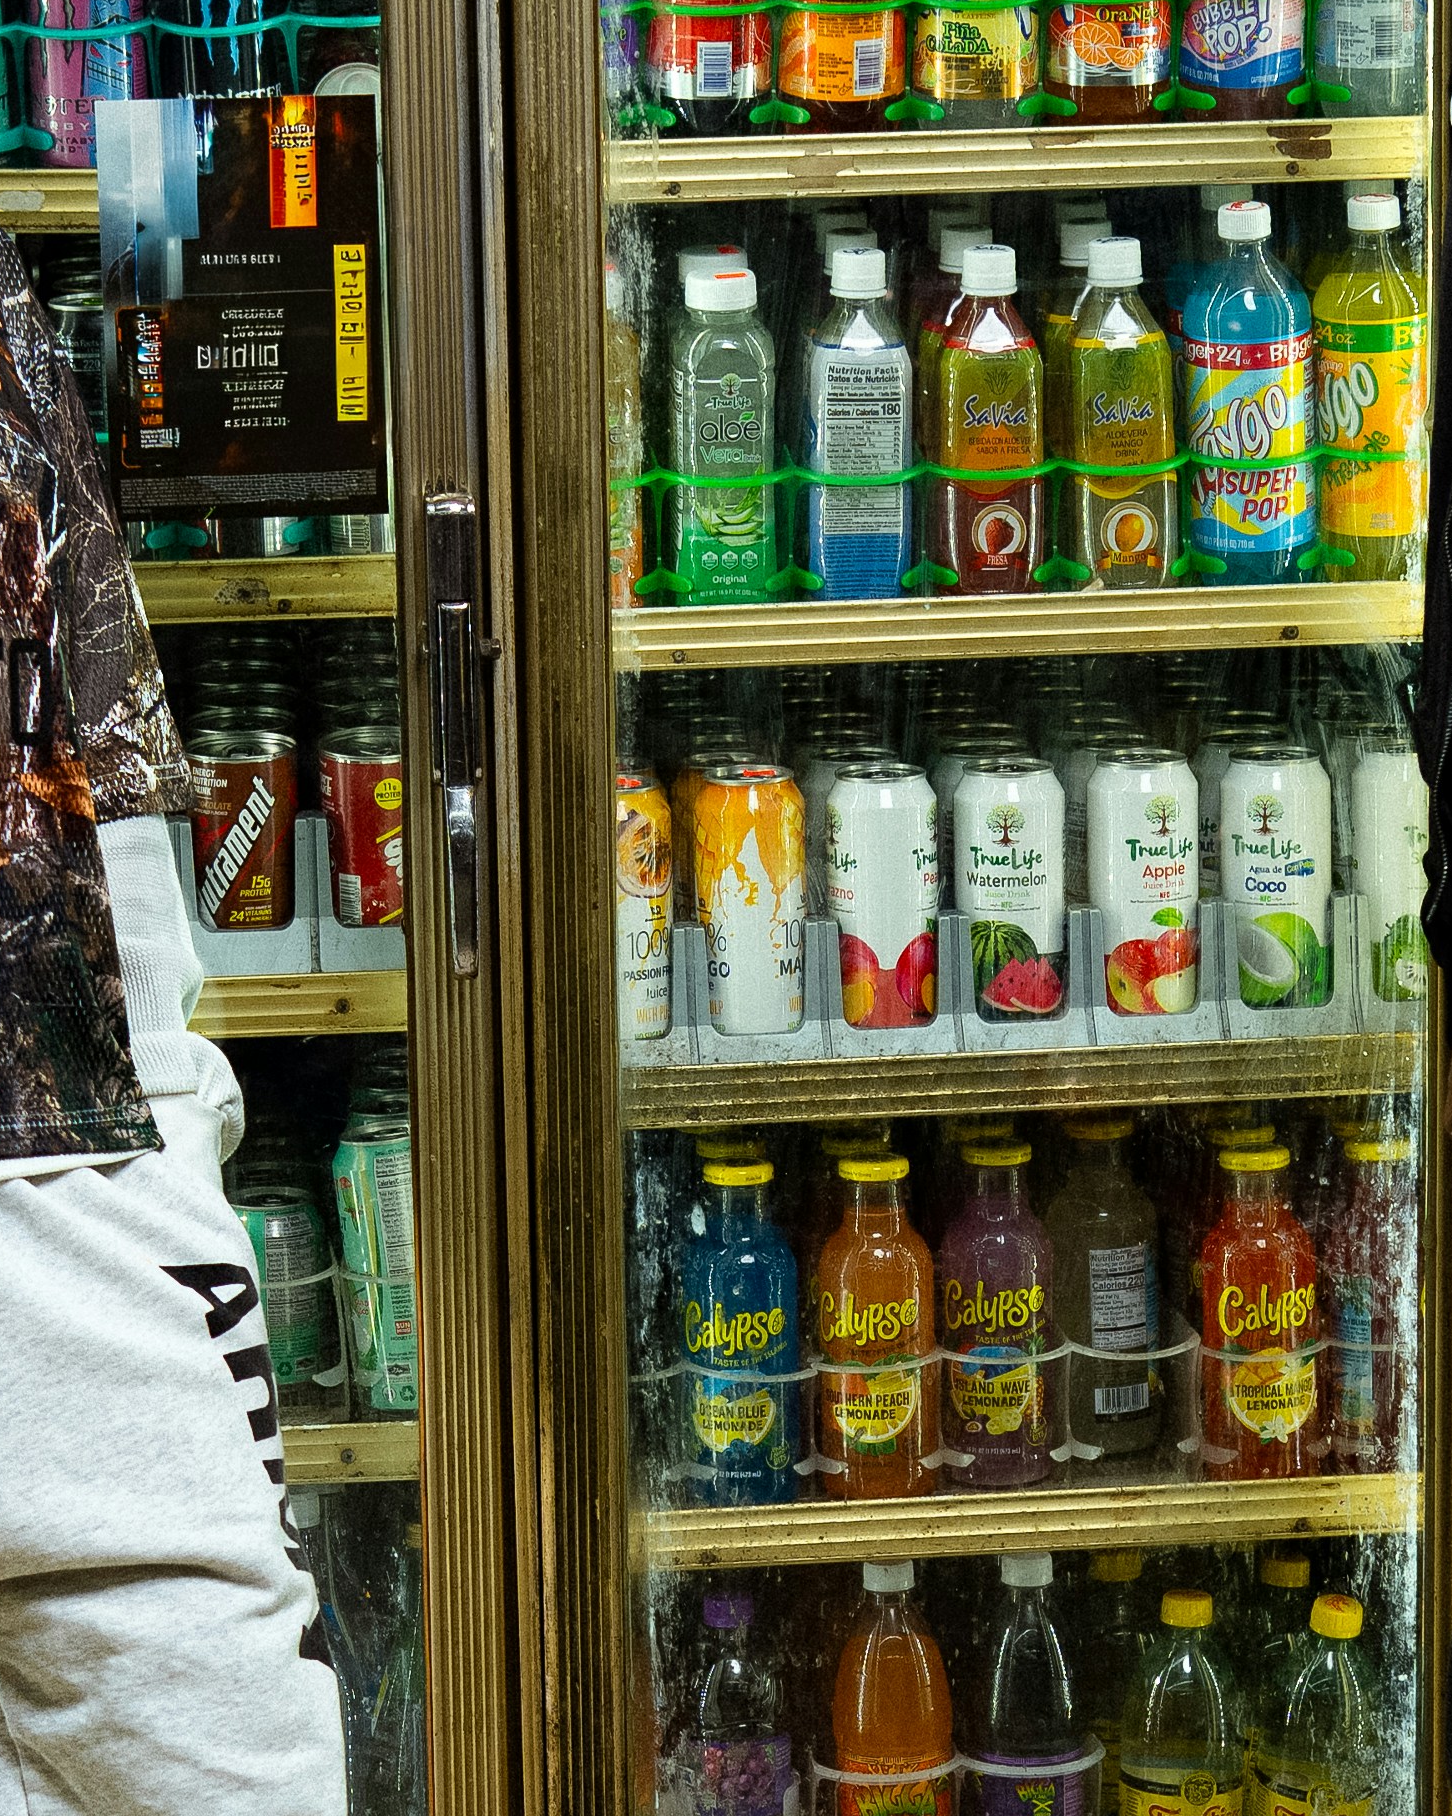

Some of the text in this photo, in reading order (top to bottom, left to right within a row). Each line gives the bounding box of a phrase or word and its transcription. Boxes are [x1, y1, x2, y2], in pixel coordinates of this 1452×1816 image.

[943, 20, 980, 38] Piña
[1216, 344, 1241, 367] 24
[827, 364, 900, 376] Nutrition Facts
[827, 373, 901, 384] Datos Nutrición
[880, 402, 901, 417] 180
[699, 413, 761, 443] aloe
[975, 445, 1032, 455] SABOR FRESA
[1110, 439, 1144, 450] MANGO
[699, 445, 745, 465] Vera
[1115, 448, 1140, 459] DRINK
[1225, 465, 1298, 495] SUPER
[1241, 496, 1289, 525] POP
[986, 554, 1009, 566] FRESA
[1112, 552, 1147, 565] Mango
[711, 574, 748, 585] Original
[192, 767, 216, 782] ENERGY
[192, 775, 228, 789] NUTRITION
[1141, 861, 1186, 880] Apple
[1248, 864, 1283, 875] Agua de
[966, 870, 1047, 888] Watermelon
[1244, 876, 1287, 893] Coco
[239, 887, 272, 898] PROTEIN
[228, 910, 245, 922] 24
[623, 965, 663, 982] PASSION
[1092, 1275, 1145, 1291] Calories 220
[943, 1278, 1046, 1334] Calypso
[1217, 1283, 1316, 1338] Calypso
[819, 1289, 918, 1346] Calypso
[684, 1300, 786, 1356] Calypso
[955, 1380, 1031, 1396] ISLAND WAVE
[1234, 1384, 1284, 1399] TROPICAL
[874, 1390, 911, 1407] PEACH
[961, 1394, 1024, 1409] LEMONADE
[1246, 1396, 1306, 1411] LEMONADE
[699, 1403, 767, 1418] OCEAN BLUE
[833, 1405, 897, 1422] LEMONADE
[701, 1418, 763, 1432] LEMONADE
